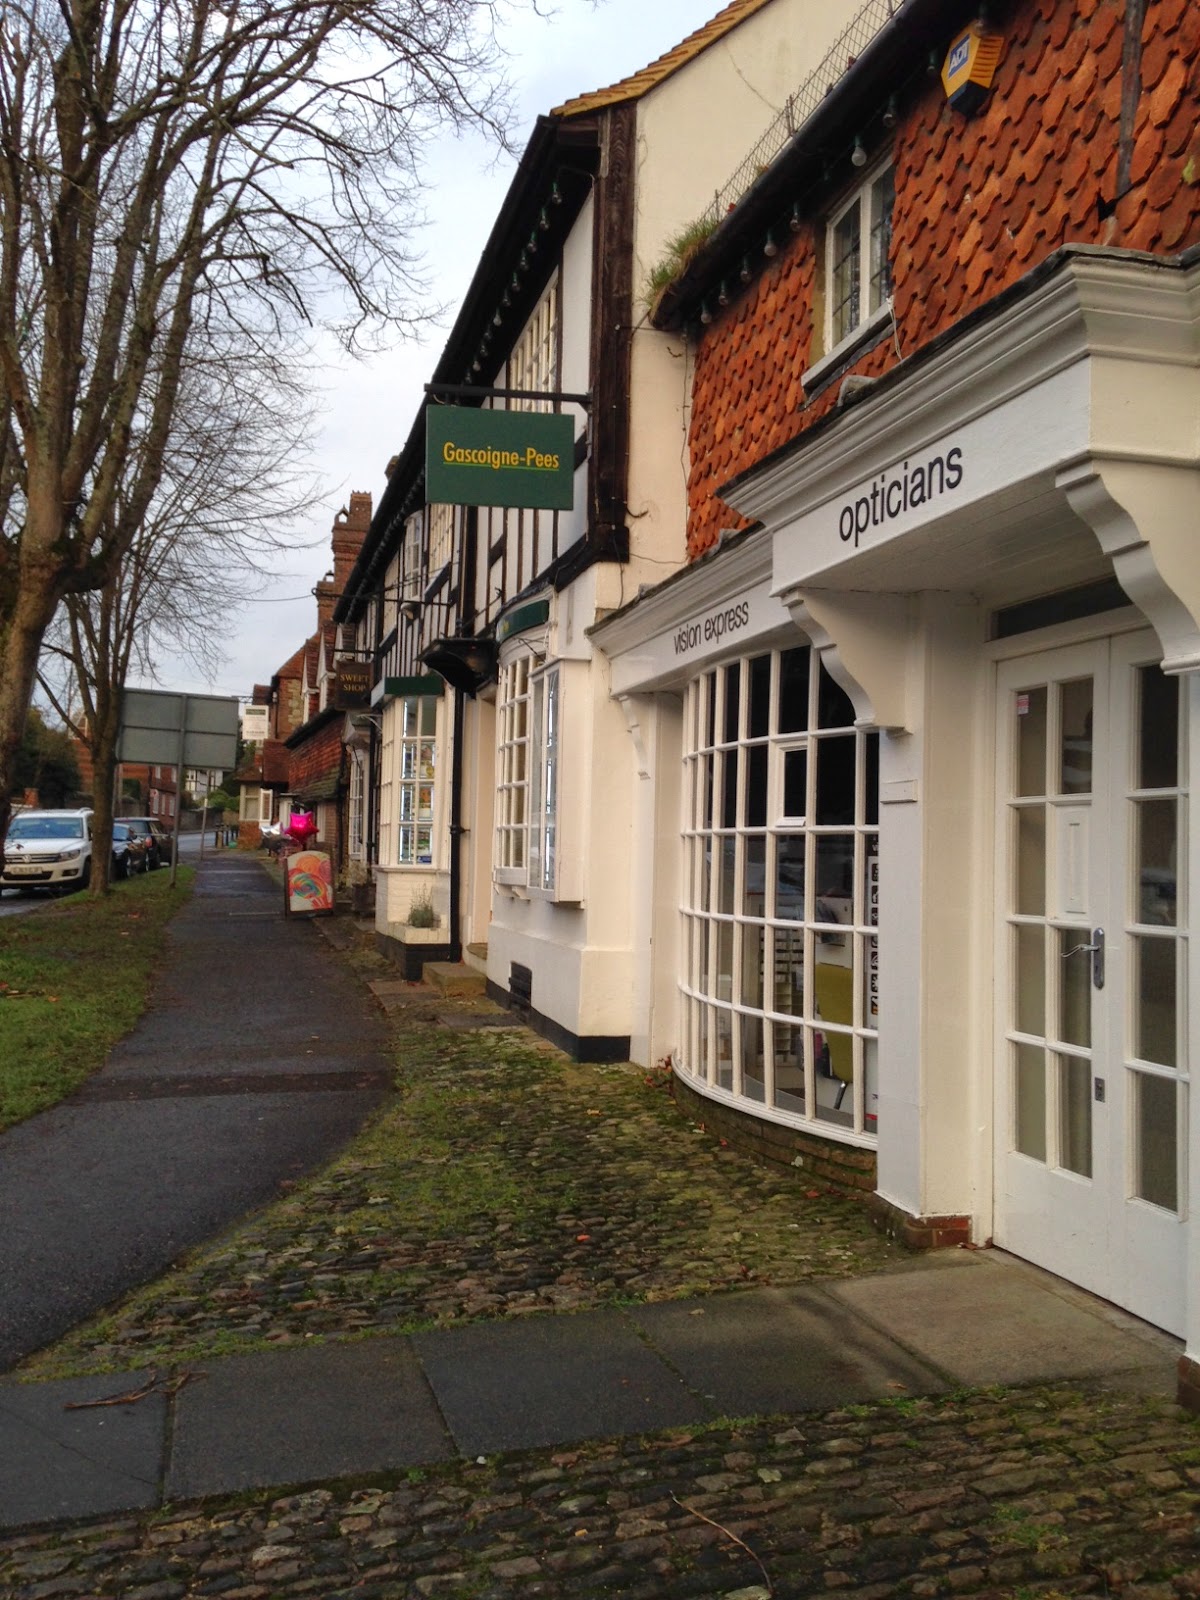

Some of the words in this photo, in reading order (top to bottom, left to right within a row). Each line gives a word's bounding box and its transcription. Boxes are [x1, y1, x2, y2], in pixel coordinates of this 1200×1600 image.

[443, 441, 560, 470] Gascoigne-Pees
[839, 447, 963, 547] opticians
[673, 623, 702, 655] vision
[704, 601, 749, 644] express
[340, 674, 369, 682] SWEET
[343, 683, 366, 692] SHOP
